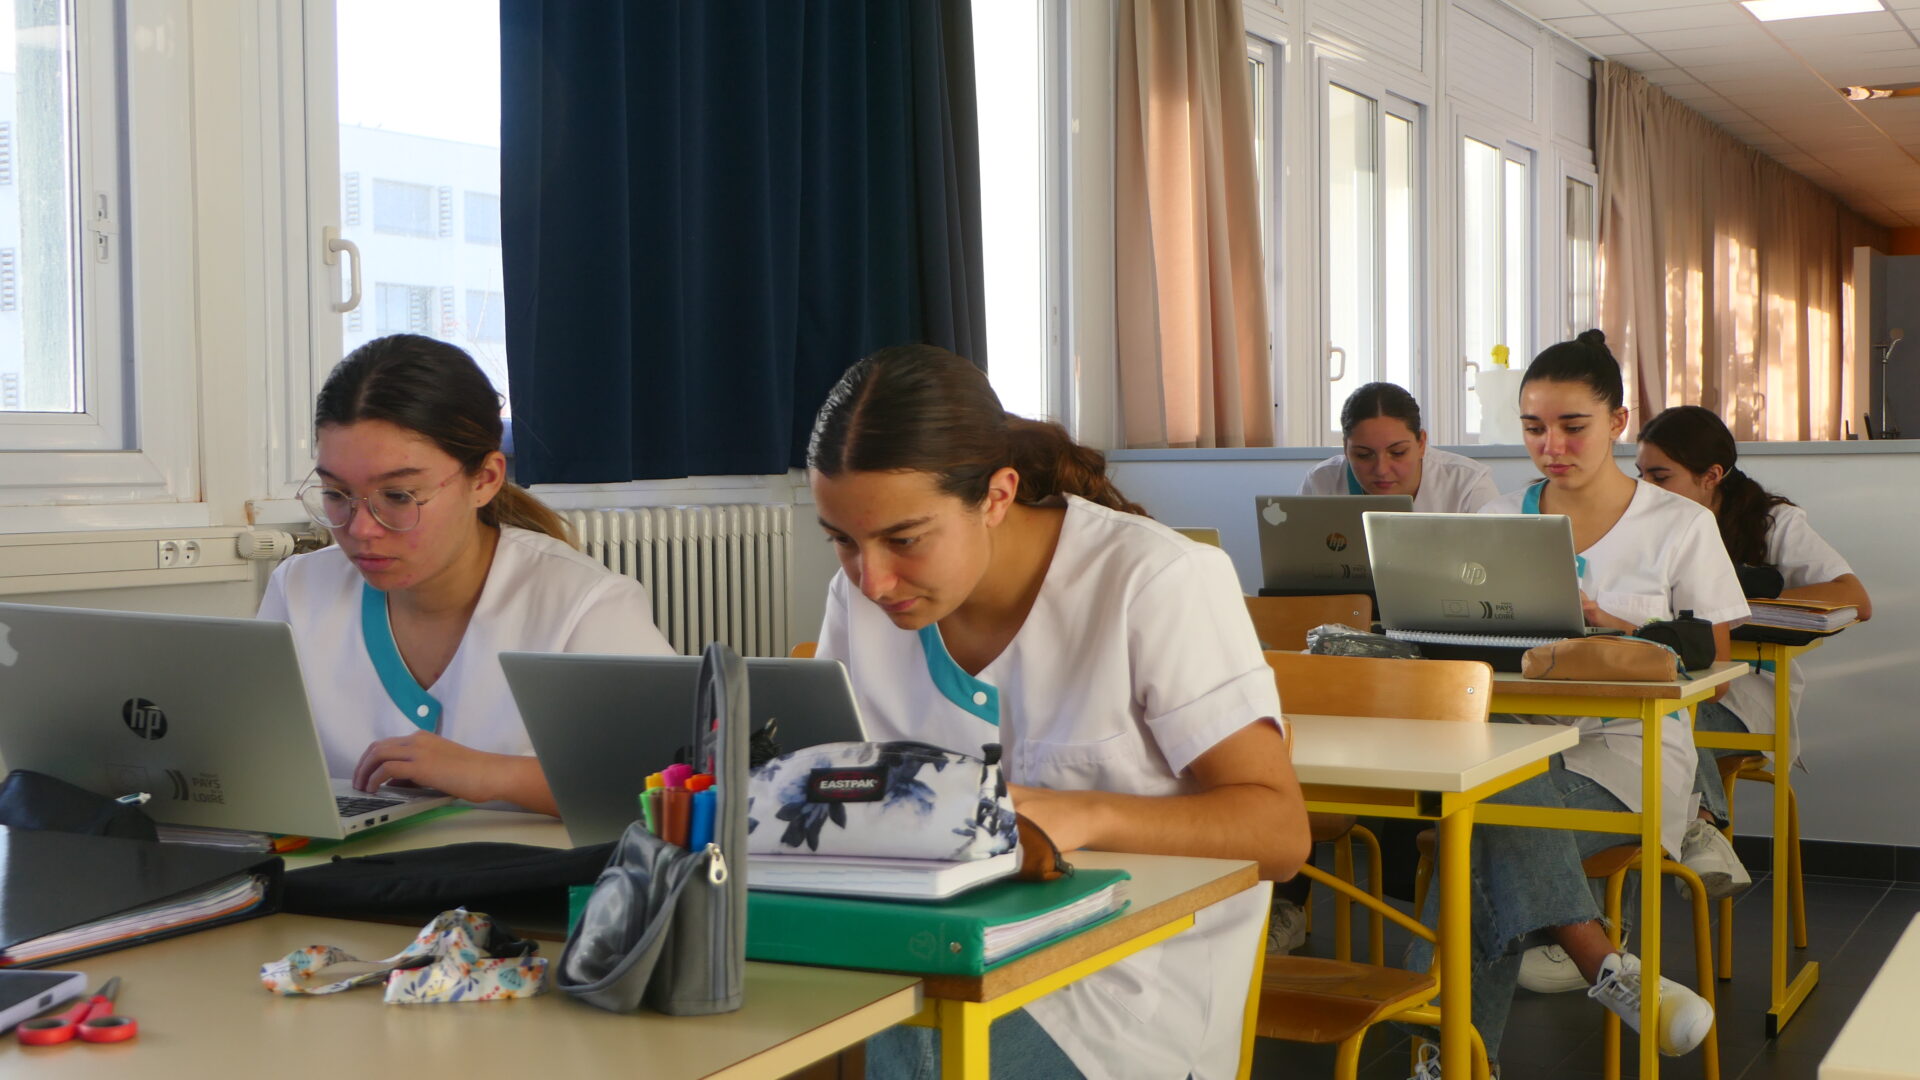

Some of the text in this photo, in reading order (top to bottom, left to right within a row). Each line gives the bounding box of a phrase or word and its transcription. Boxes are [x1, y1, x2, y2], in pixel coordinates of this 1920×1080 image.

[1329, 533, 1345, 551] hp
[1461, 562, 1483, 585] hp
[129, 698, 161, 740] hp
[192, 777, 221, 789] PAYS
[819, 779, 875, 789] EASTPAK
[192, 791, 225, 804] LOIRE
